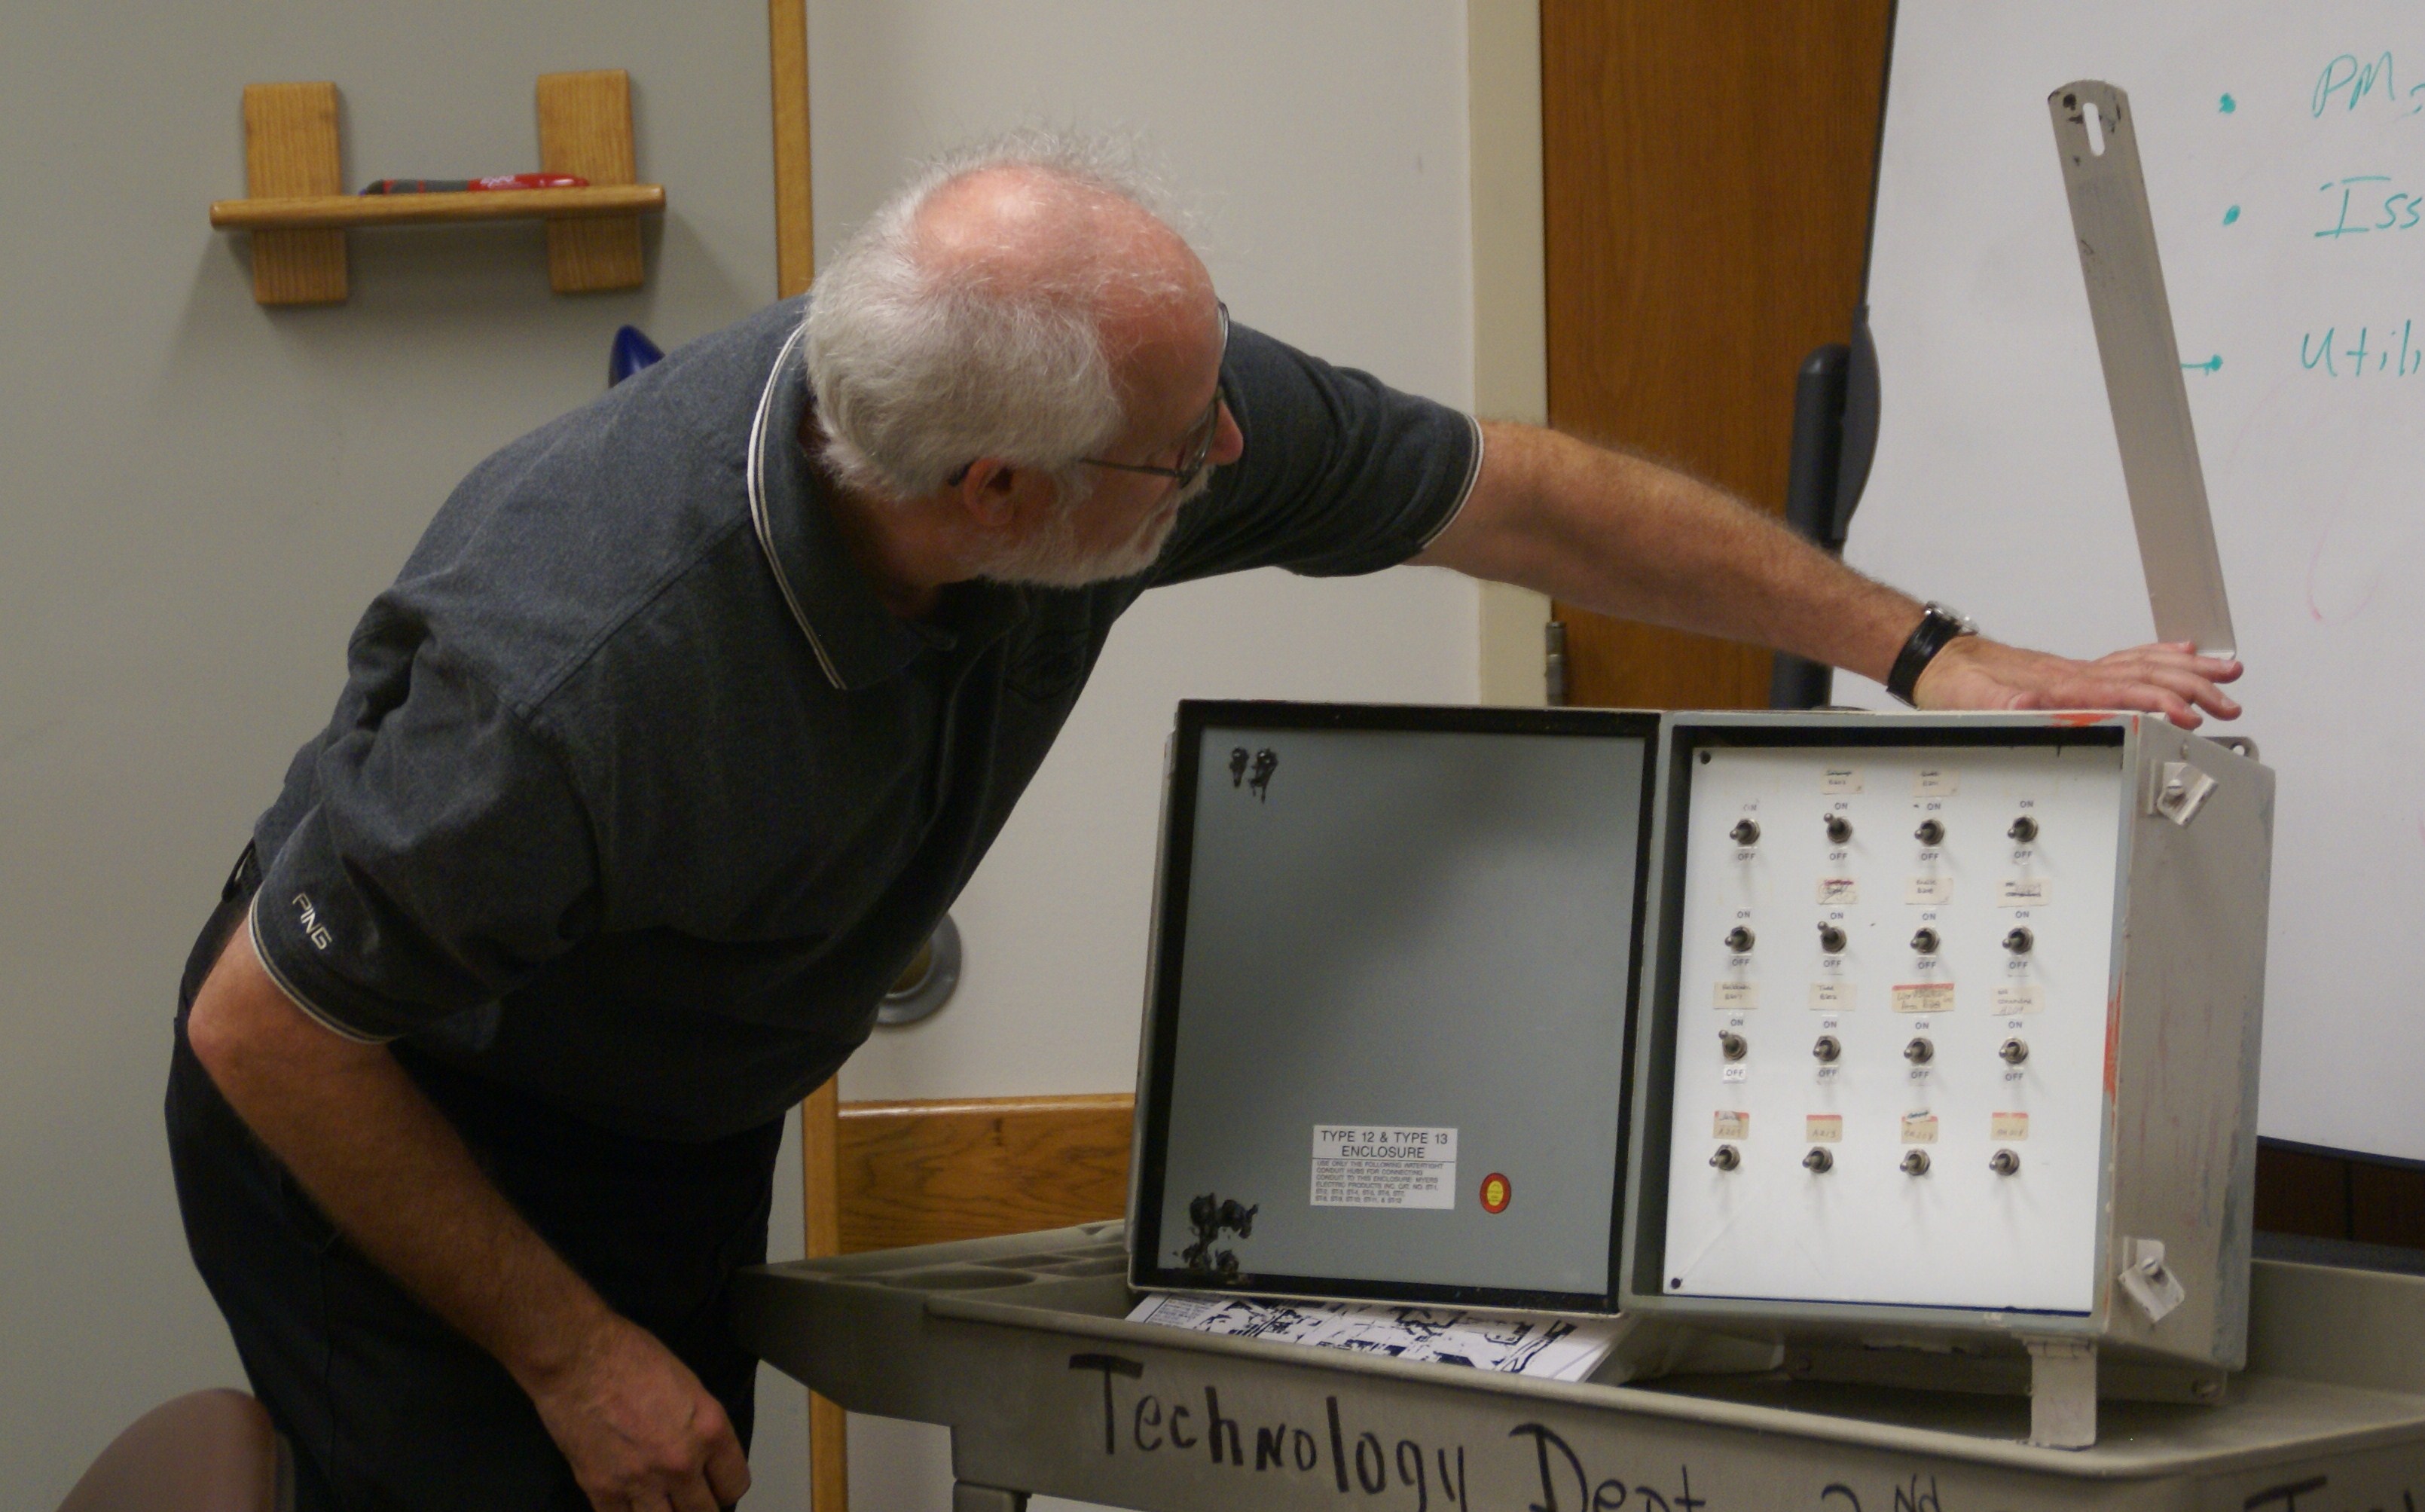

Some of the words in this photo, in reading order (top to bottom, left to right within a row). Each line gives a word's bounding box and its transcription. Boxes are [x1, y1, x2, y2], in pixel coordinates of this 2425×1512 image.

[1834, 802, 1848, 811] ON
[1926, 802, 1941, 811] ON
[2019, 800, 2034, 808] ON
[1737, 852, 1756, 861] OFF
[1829, 853, 1848, 861] OFF
[1921, 853, 1940, 861] OFF
[2014, 850, 2033, 859] OFF
[1736, 910, 1751, 918] ON
[2015, 910, 2030, 918] ON
[292, 892, 333, 951] PING
[1731, 958, 1751, 967] OFF
[1917, 961, 1937, 970] OFF
[2009, 961, 2029, 970] OFF
[1730, 1019, 1744, 1027] ON
[1823, 1021, 1837, 1029] ON
[1915, 1022, 1929, 1030] ON
[2008, 1021, 2023, 1029] ON
[1726, 1068, 1744, 1077] OFF
[1818, 1069, 1837, 1077] OFF
[1910, 1071, 1930, 1080] OFF
[2005, 1073, 2024, 1081] OFF
[1321, 1130, 1355, 1143] TYPE
[1362, 1132, 1375, 1143] 12
[1379, 1132, 1388, 1144] &
[1394, 1132, 1428, 1144] TYPE
[1434, 1133, 1449, 1145] 13
[1342, 1146, 1425, 1159] ENCLOSURE
[1067, 1353, 1468, 1512] Technology
